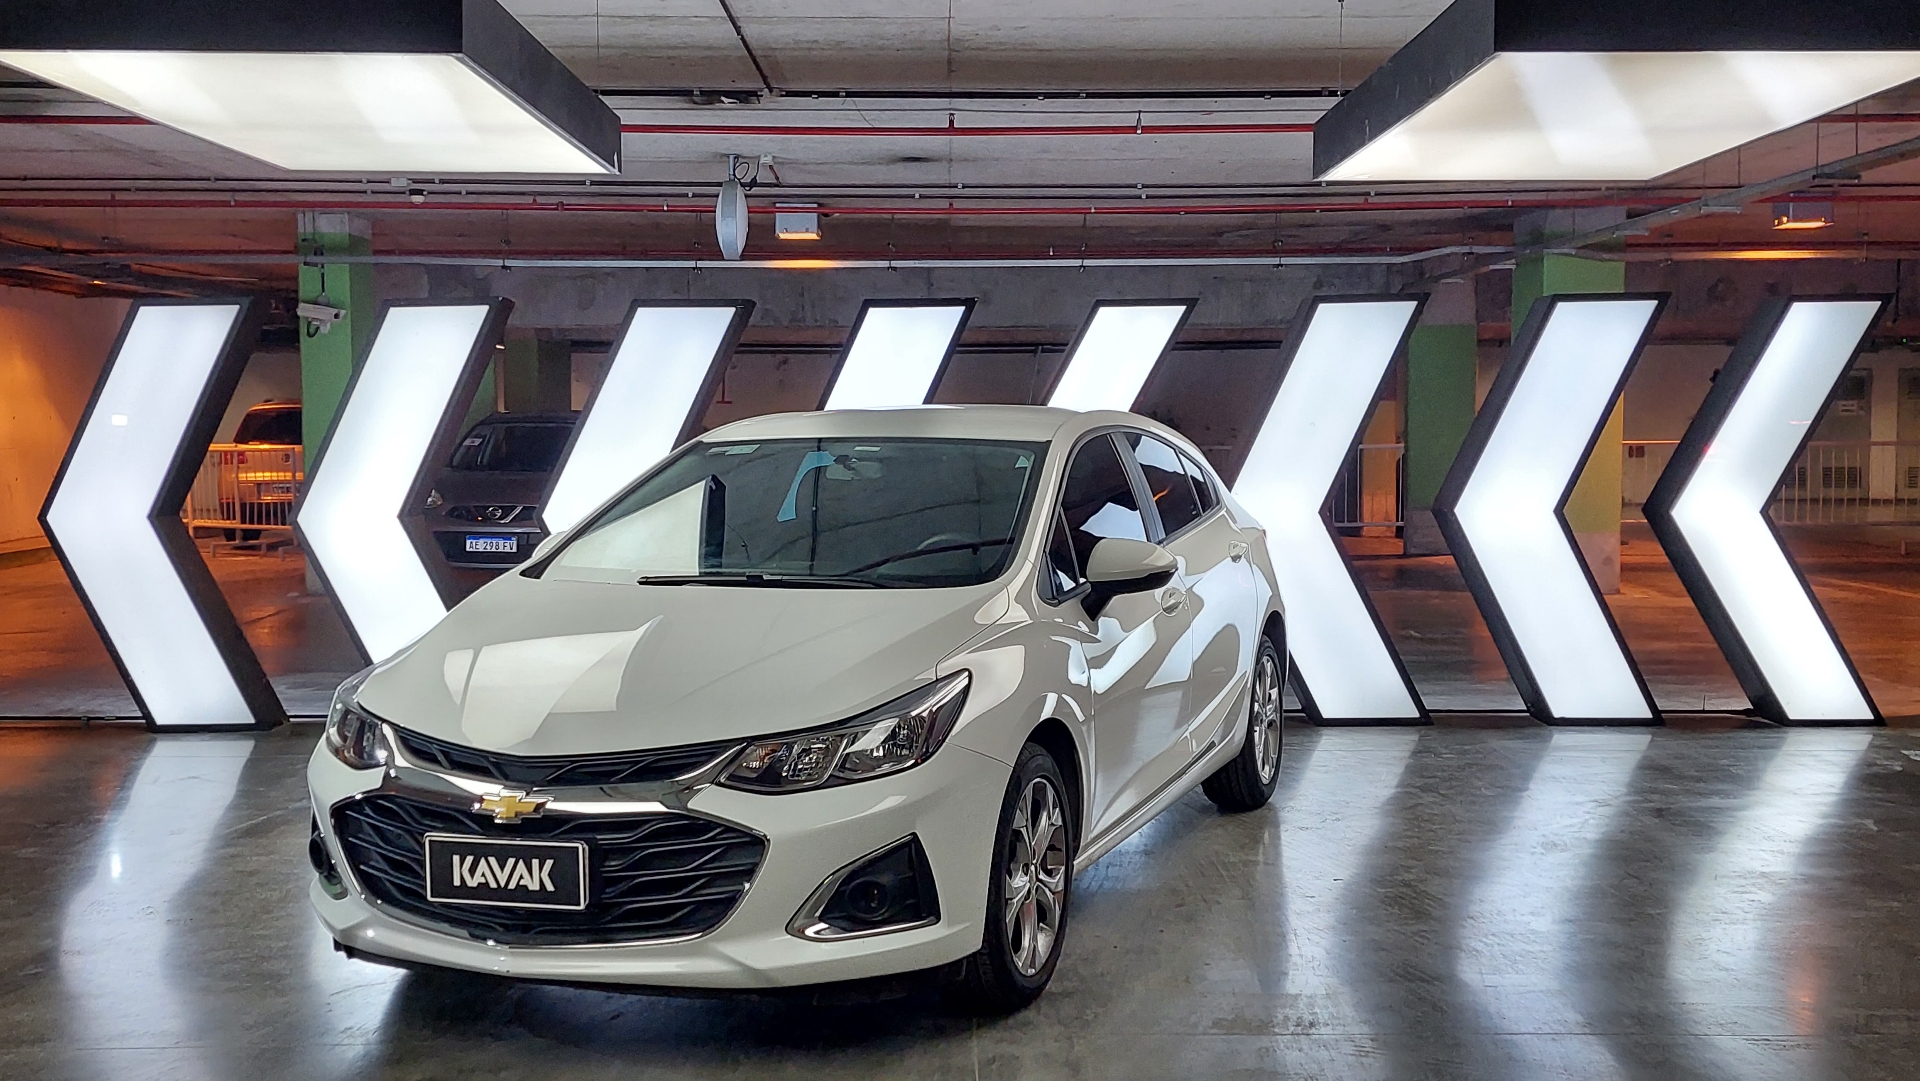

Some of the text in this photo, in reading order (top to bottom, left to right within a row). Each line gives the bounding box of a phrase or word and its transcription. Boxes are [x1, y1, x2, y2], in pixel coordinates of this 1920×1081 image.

[469, 541, 514, 551] AE 298 FV
[452, 854, 556, 892] KAVAK
